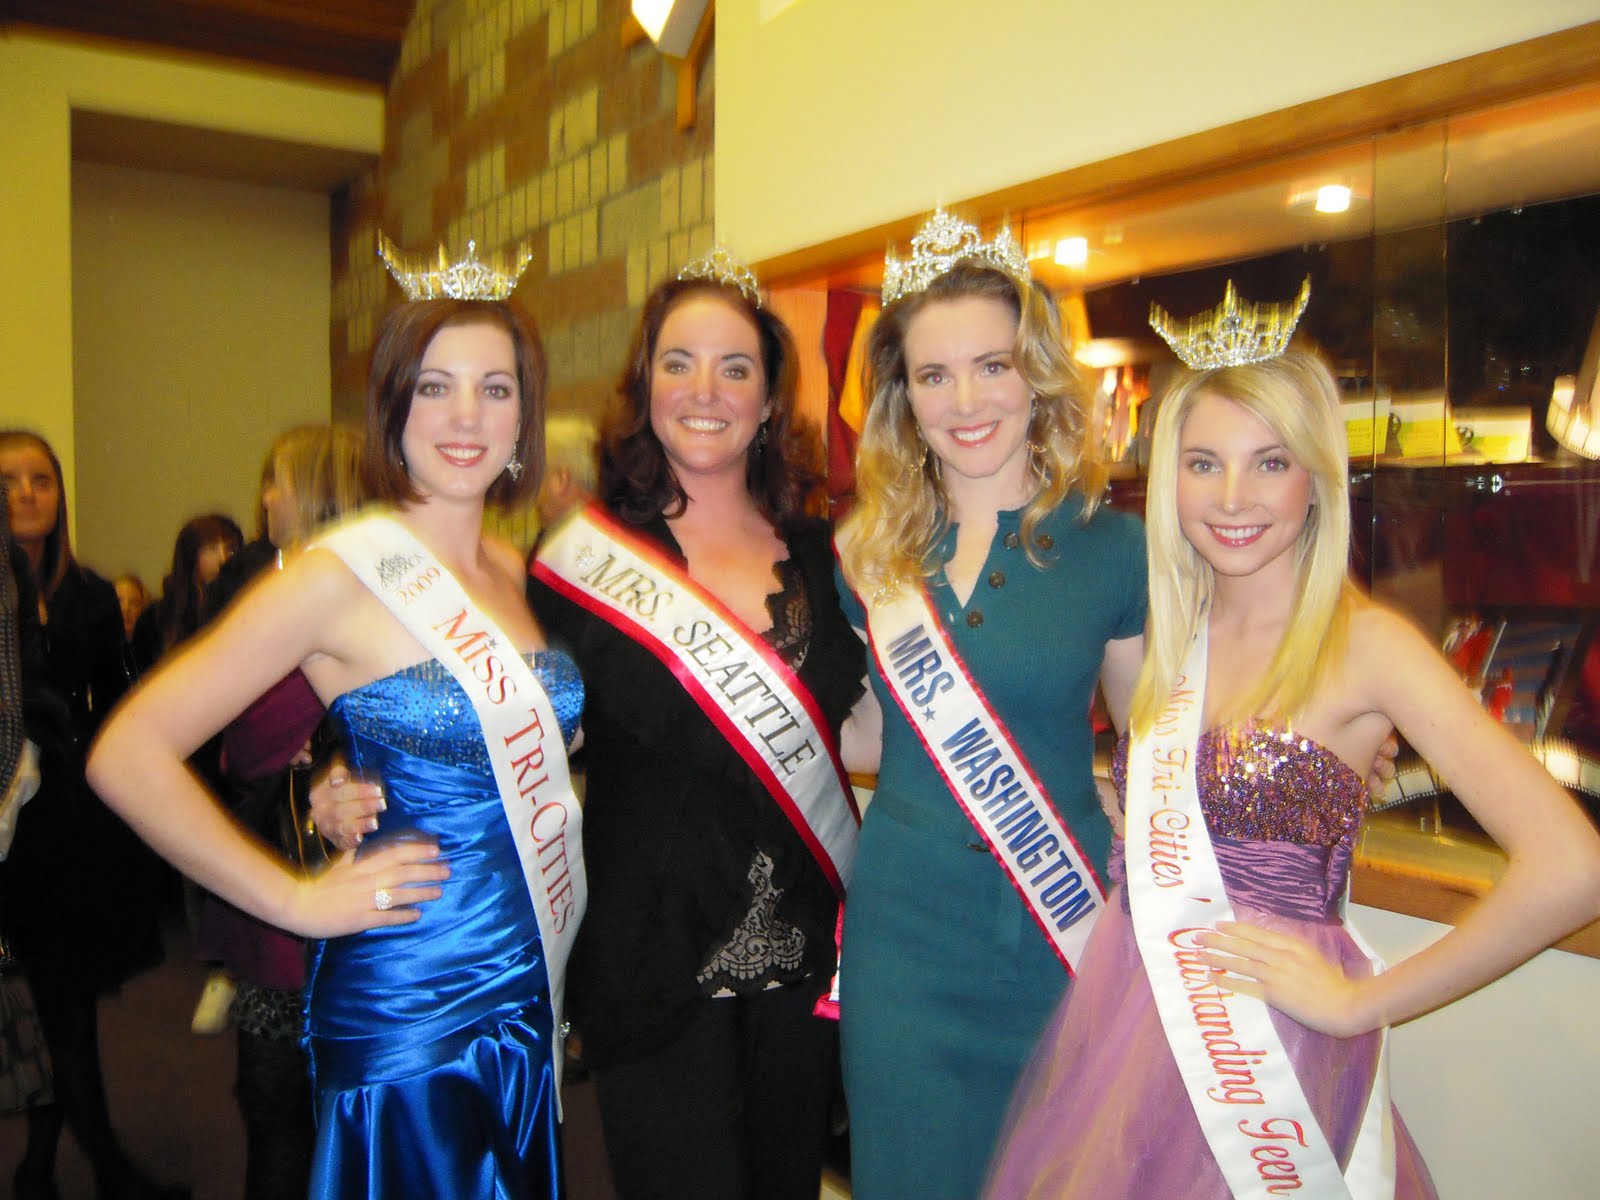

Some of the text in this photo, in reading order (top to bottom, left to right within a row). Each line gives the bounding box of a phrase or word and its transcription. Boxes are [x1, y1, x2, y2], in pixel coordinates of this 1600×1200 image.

[399, 567, 441, 606] 2009
[580, 553, 817, 776] MRS. SEATTLE
[503, 708, 575, 935] TRI-CITIES
[940, 717, 1096, 933] WASHINGTON
[1237, 1117, 1309, 1196] Teen
